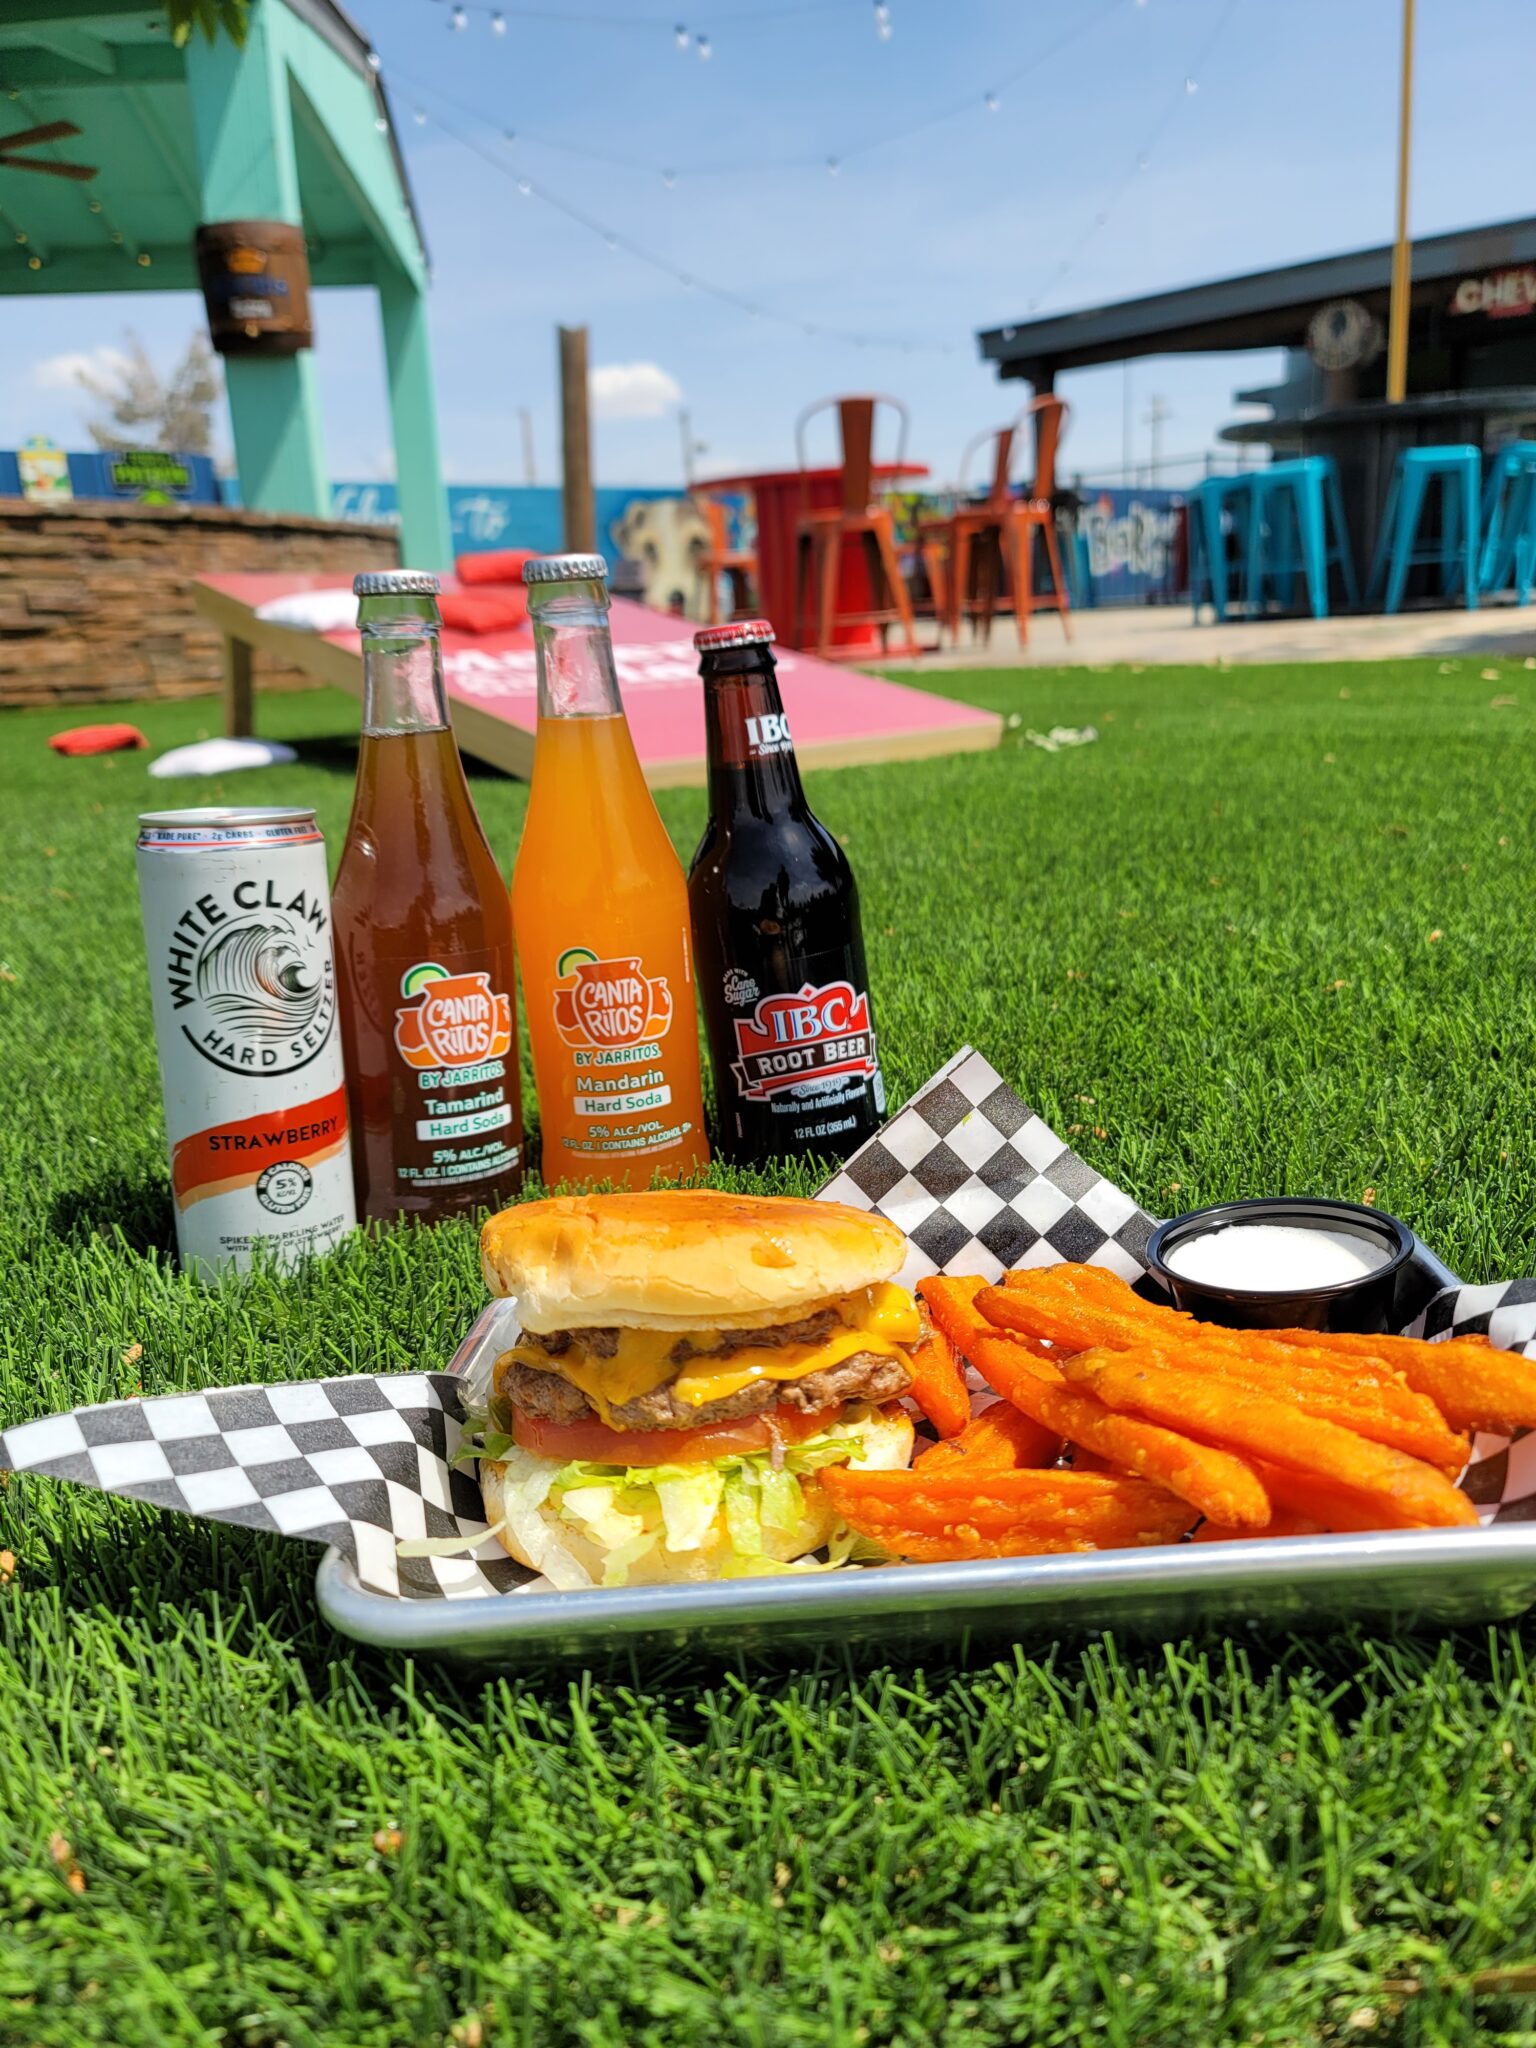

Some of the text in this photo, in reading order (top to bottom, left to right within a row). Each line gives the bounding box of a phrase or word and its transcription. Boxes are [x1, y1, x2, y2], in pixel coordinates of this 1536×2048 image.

[226, 830, 254, 840] CARBS
[168, 880, 328, 1010] WHITE CLAW
[580, 978, 643, 1008] CANTA
[731, 975, 756, 991] Cane
[724, 984, 760, 1006] Sugar
[203, 959, 333, 1066] HARD SELTZER
[427, 993, 489, 1027] CANTA
[771, 997, 848, 1043] IBC
[576, 1044, 659, 1065] BY JARRITOS
[757, 1037, 866, 1076] ROOT BEER
[420, 1062, 504, 1087] BY JARRITOS
[576, 1069, 664, 1092] Mandarin
[799, 1077, 843, 1096] Since 1919
[424, 1086, 504, 1115] Tamarind
[585, 1092, 662, 1112] Hard Soda
[771, 1101, 800, 1113] Naturally
[801, 1099, 814, 1111] and
[815, 1093, 845, 1109] Artificially
[209, 1117, 338, 1150] STRAWBERRY
[430, 1112, 504, 1136] Hard Soda
[589, 1125, 610, 1138] 5%
[794, 1127, 804, 1139] 12
[805, 1126, 815, 1138] FL
[816, 1123, 826, 1136] OZ
[827, 1119, 843, 1135] (355
[602, 1137, 646, 1151] CONTAINS
[648, 1127, 682, 1144] ALCOHOL
[432, 1148, 457, 1164] 5%
[447, 1159, 491, 1176] CONTAINS
[275, 1177, 298, 1190] 5%
